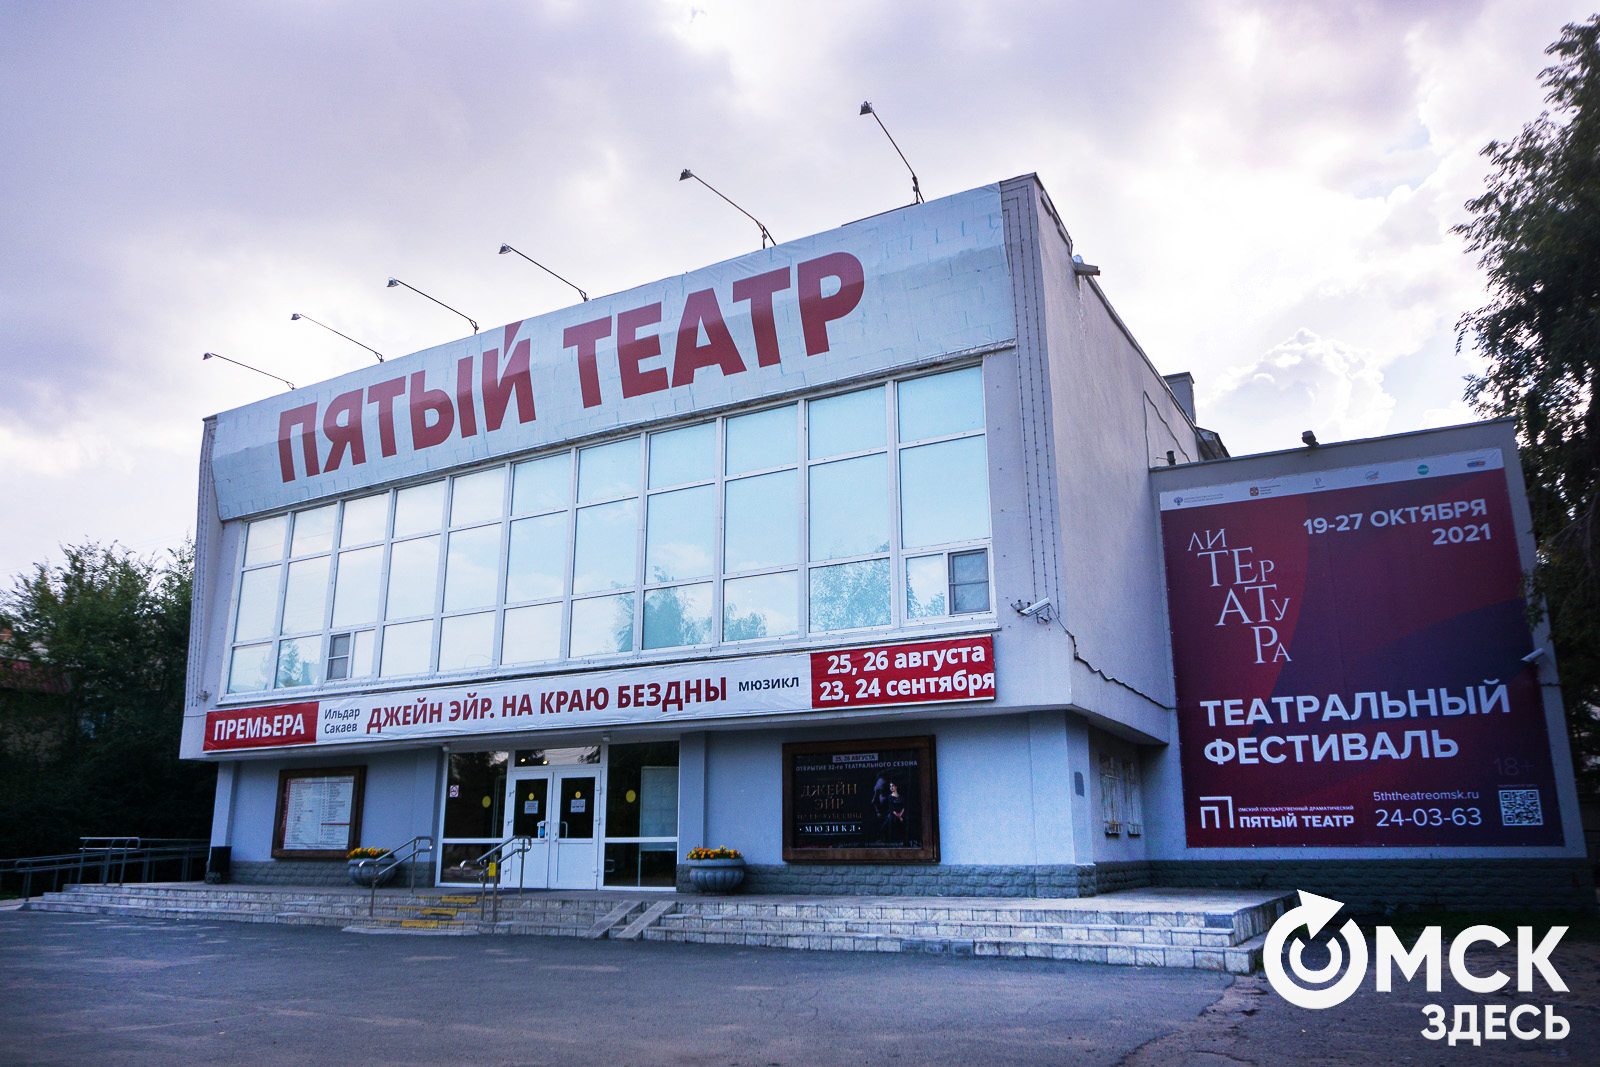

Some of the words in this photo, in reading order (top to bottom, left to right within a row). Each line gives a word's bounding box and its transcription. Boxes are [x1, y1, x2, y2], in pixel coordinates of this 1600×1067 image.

[278, 322, 536, 483] ПЯТЫЙ
[563, 252, 865, 409] ТЕАТР
[1303, 513, 1363, 535] 19-27
[1370, 498, 1488, 528] ОКТЯБРЯ
[1431, 523, 1491, 545] 2021
[827, 655, 858, 678] 25,
[863, 652, 889, 672] 26
[894, 645, 986, 671] августа
[819, 680, 851, 703] 23,
[855, 678, 881, 699] 24
[885, 669, 995, 696] сентября
[324, 706, 361, 721] Ильдар
[366, 697, 443, 734] ДЖЕЙН
[448, 692, 494, 722] ЭЙР.
[501, 695, 538, 719] НА
[540, 686, 610, 716] КРАЮ
[617, 676, 727, 712] БЕЗДНЫ
[1200, 679, 1511, 727] ТЕАТРАЛЬНЫЙ
[213, 713, 305, 741] ПРЕМЬЕРА
[324, 721, 358, 734] Сакаев
[1203, 729, 1459, 765] ФЕСТИВАЛЬ
[795, 764, 827, 772] ОТКРЫТИЕ
[845, 761, 892, 769] ТЕАТРАЛЬНОГО
[893, 759, 918, 768] СЕЗОНА
[1494, 757, 1535, 776] 18+
[800, 781, 857, 797] ДЖЕЙН
[1373, 789, 1480, 803] 5ththeatreomsk.ru
[814, 796, 844, 810] ЭЙР
[1240, 813, 1298, 828] ПЯТЫЙ
[1301, 815, 1355, 828] ТЕАТР
[1375, 807, 1482, 827] 24-03-63
